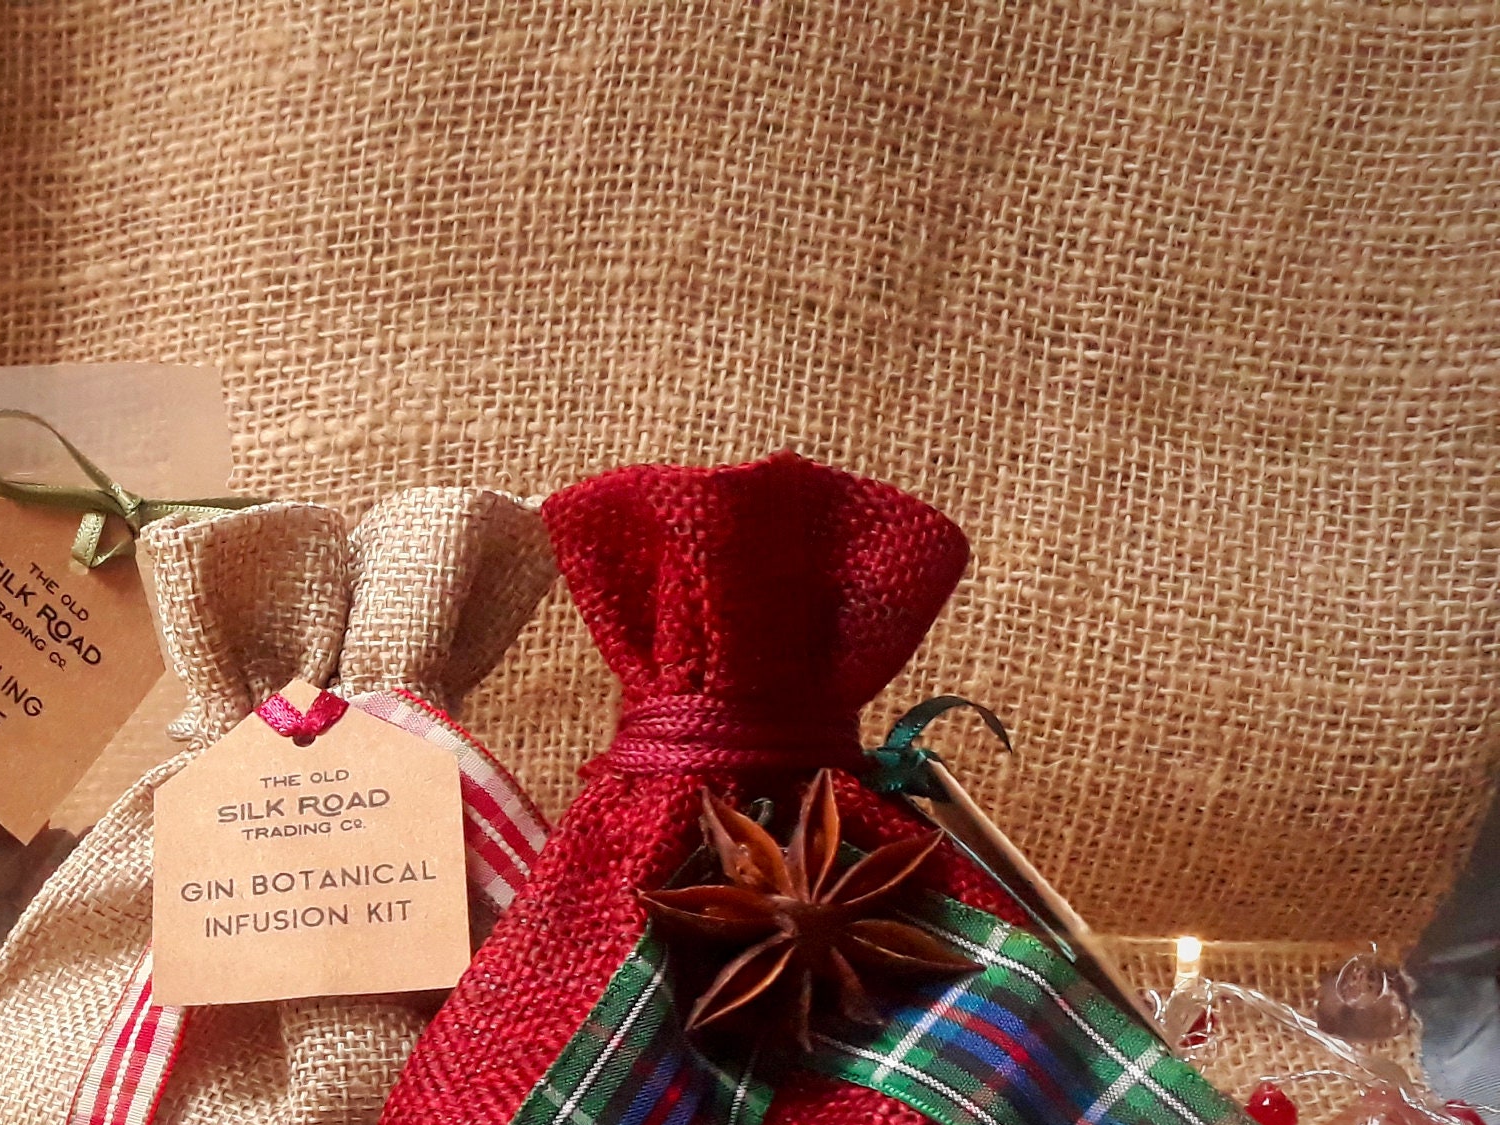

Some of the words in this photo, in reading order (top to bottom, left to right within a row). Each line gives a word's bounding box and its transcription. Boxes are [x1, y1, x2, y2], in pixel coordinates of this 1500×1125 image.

[29, 562, 60, 595] THE
[60, 594, 89, 622] OLD
[36, 604, 101, 666] ROAD
[260, 774, 301, 788] THE
[310, 769, 349, 784] OLD
[217, 797, 285, 823] SILK
[297, 788, 390, 817] ROAD
[241, 821, 332, 841] TRADING
[181, 878, 234, 902] GIN
[252, 860, 436, 895] BOTANICAL
[205, 904, 348, 937] INFUSION
[367, 900, 412, 923] KIT
